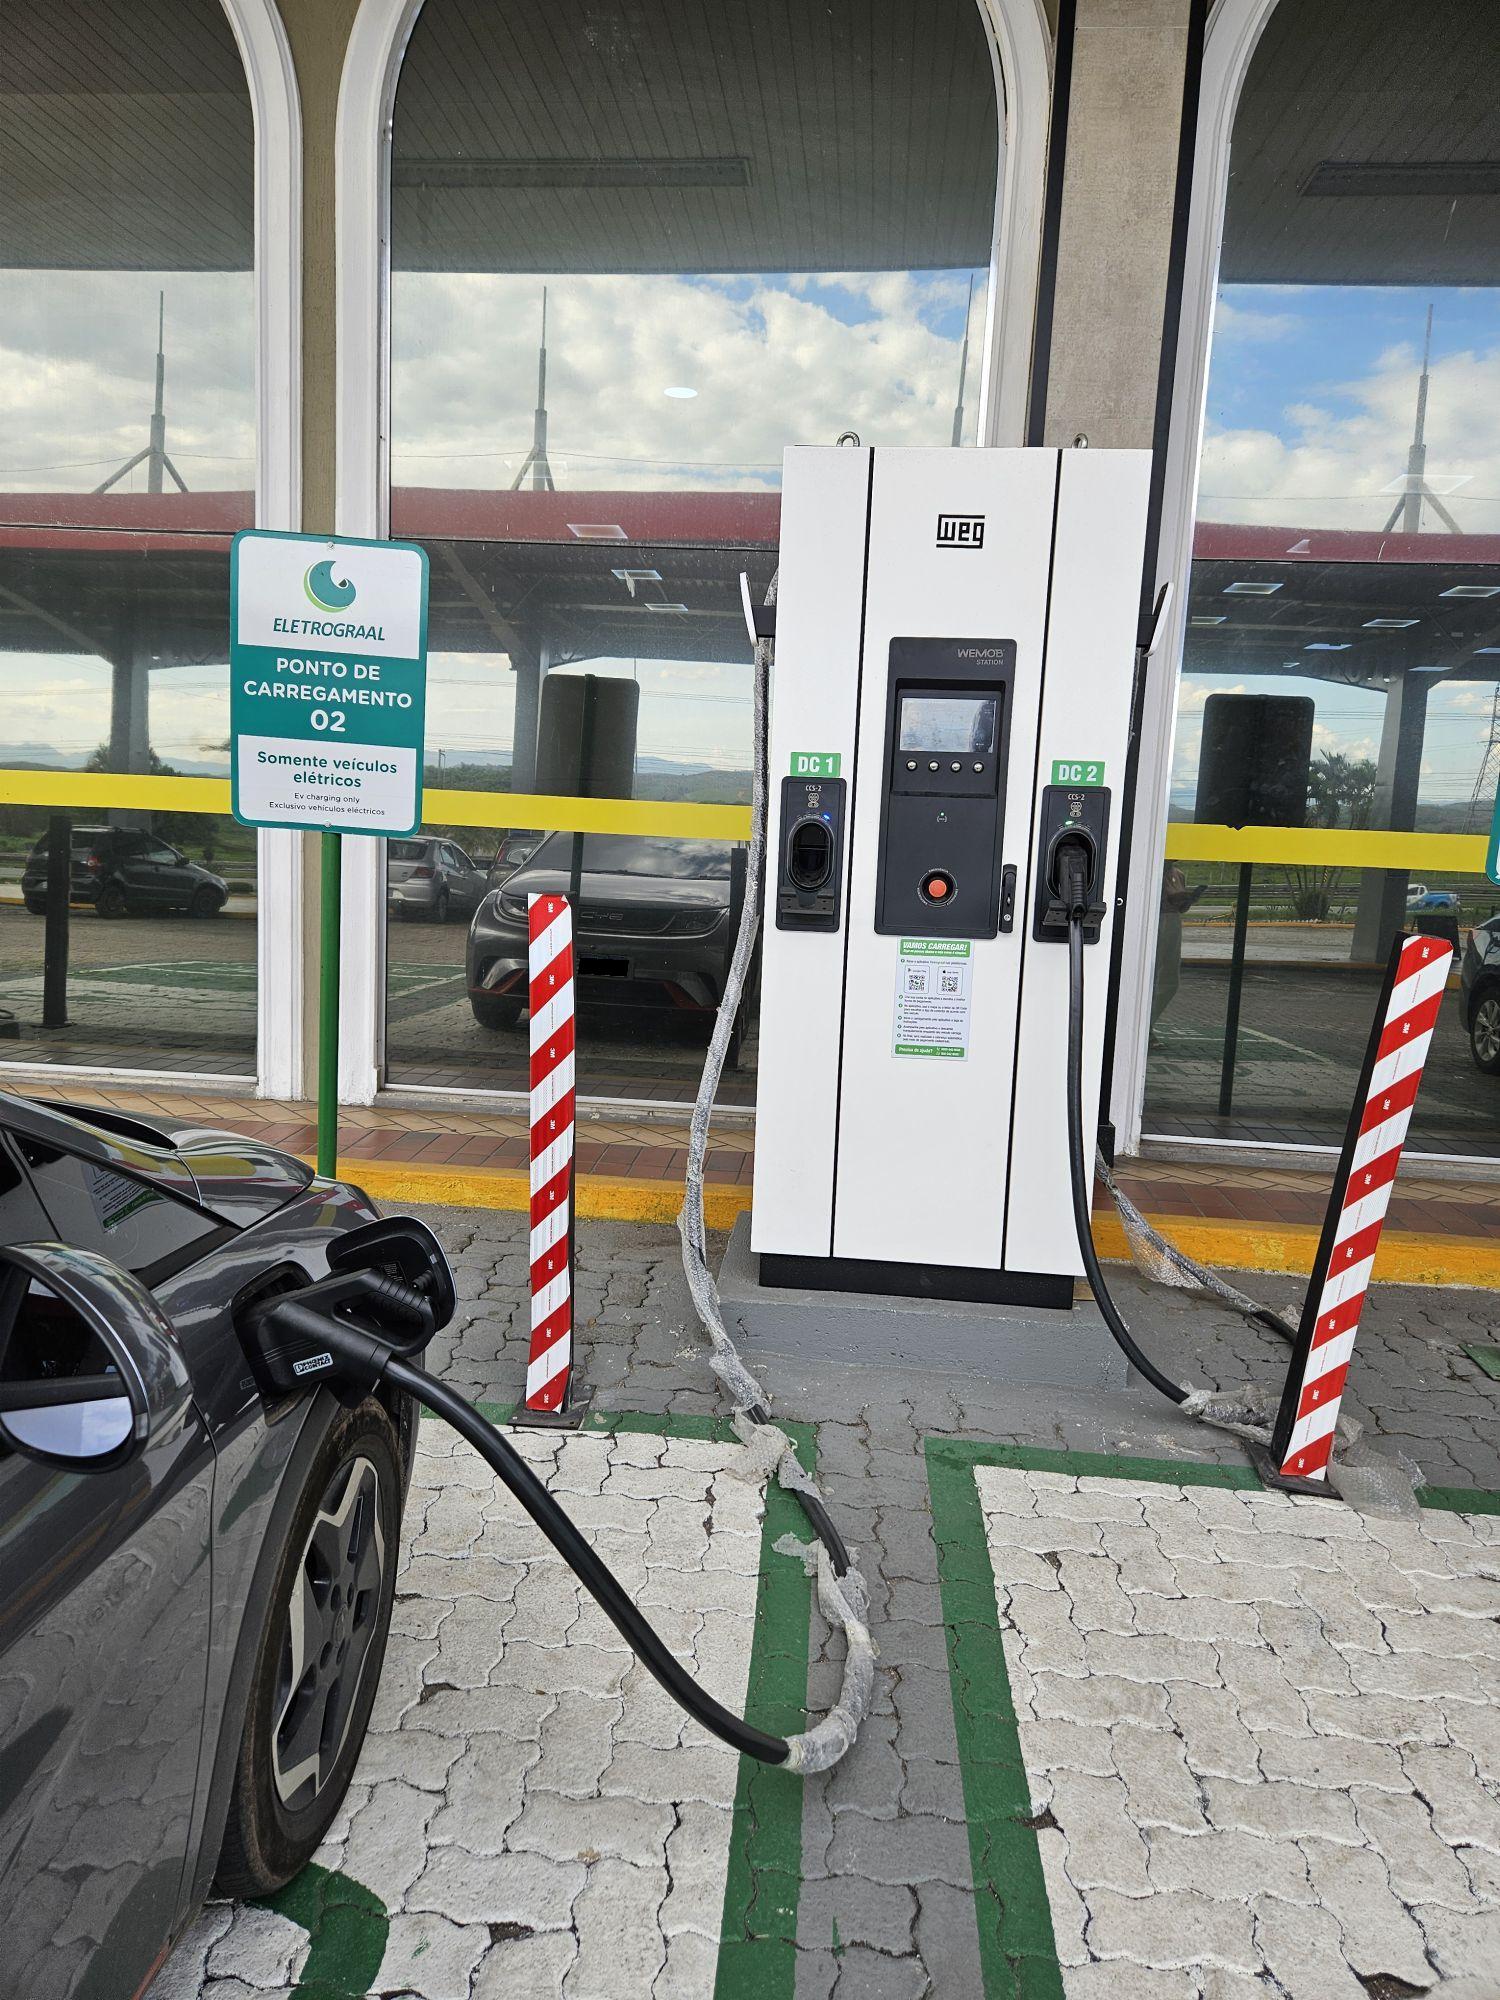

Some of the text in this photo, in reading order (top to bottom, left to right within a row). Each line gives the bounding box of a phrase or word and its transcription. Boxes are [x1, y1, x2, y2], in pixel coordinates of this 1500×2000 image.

[273, 618, 385, 640] ELETROGRAAL
[276, 658, 380, 681] PONTO DE
[243, 681, 412, 708] CARREGAMENTO
[310, 709, 346, 732] 02
[257, 751, 397, 774] Somente veículos
[798, 756, 833, 773] DC 1
[1059, 764, 1097, 782] DC 2
[293, 771, 362, 788] elétricos
[306, 793, 341, 803] charging
[343, 796, 360, 804] only
[1067, 793, 1085, 801] CCS-2
[269, 802, 306, 810] Exclusivo
[547, 902, 554, 913] 3M
[928, 943, 967, 951] CARREGAR!
[1421, 946, 1430, 959] 3M
[549, 974, 555, 985] 3M
[1402, 1022, 1411, 1034] 3M
[549, 1047, 556, 1058] 3M
[1382, 1098, 1391, 1110] 3M
[549, 1119, 556, 1130] 3M
[1364, 1173, 1372, 1185] 3M
[549, 1190, 555, 1201] 3M
[1345, 1247, 1354, 1258] 3M
[547, 1259, 554, 1270] 3M
[1328, 1319, 1336, 1330] 3M
[545, 1327, 552, 1338] 3M
[543, 1393, 549, 1404] 3M
[1312, 1389, 1320, 1401] 3M
[1297, 1458, 1305, 1469] 3M
